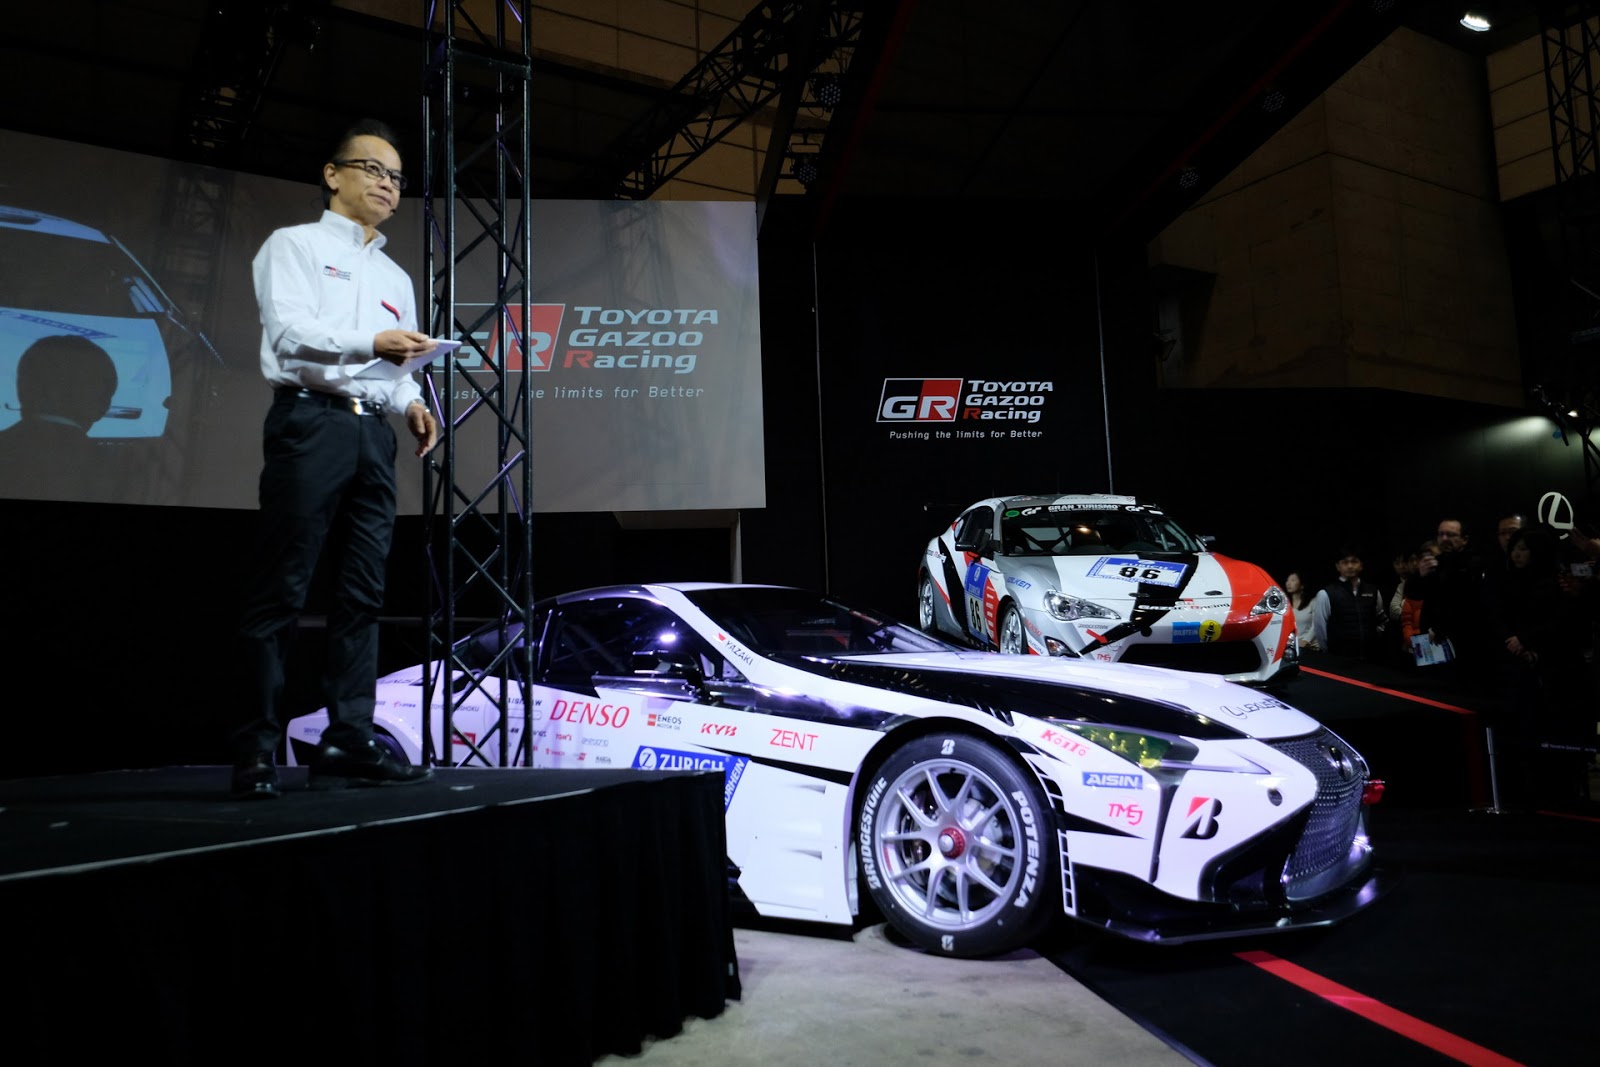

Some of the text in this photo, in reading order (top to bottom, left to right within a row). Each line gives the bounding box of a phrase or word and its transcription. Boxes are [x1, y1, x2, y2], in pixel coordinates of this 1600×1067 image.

[574, 306, 719, 325] TOYOTA
[568, 328, 704, 347] GAZOO
[564, 350, 697, 374] Racing
[554, 387, 603, 398] limits
[614, 387, 639, 398] for
[648, 386, 704, 398] Better
[968, 380, 1054, 393] TOYOTA
[882, 396, 956, 419] GR
[965, 394, 1045, 406] GAZOO
[962, 407, 1042, 424] Racing
[889, 430, 1043, 440] Pushing the limits for Better
[1119, 566, 1161, 580] 86
[726, 640, 754, 666] YAZAKI
[550, 699, 630, 728] DENSO
[658, 714, 682, 724] ENEOS
[700, 723, 738, 737] KYB
[769, 728, 819, 751] ZENT
[660, 753, 725, 770] ZURICH
[1085, 774, 1140, 788] AISIN
[1011, 790, 1041, 908] POTENZA
